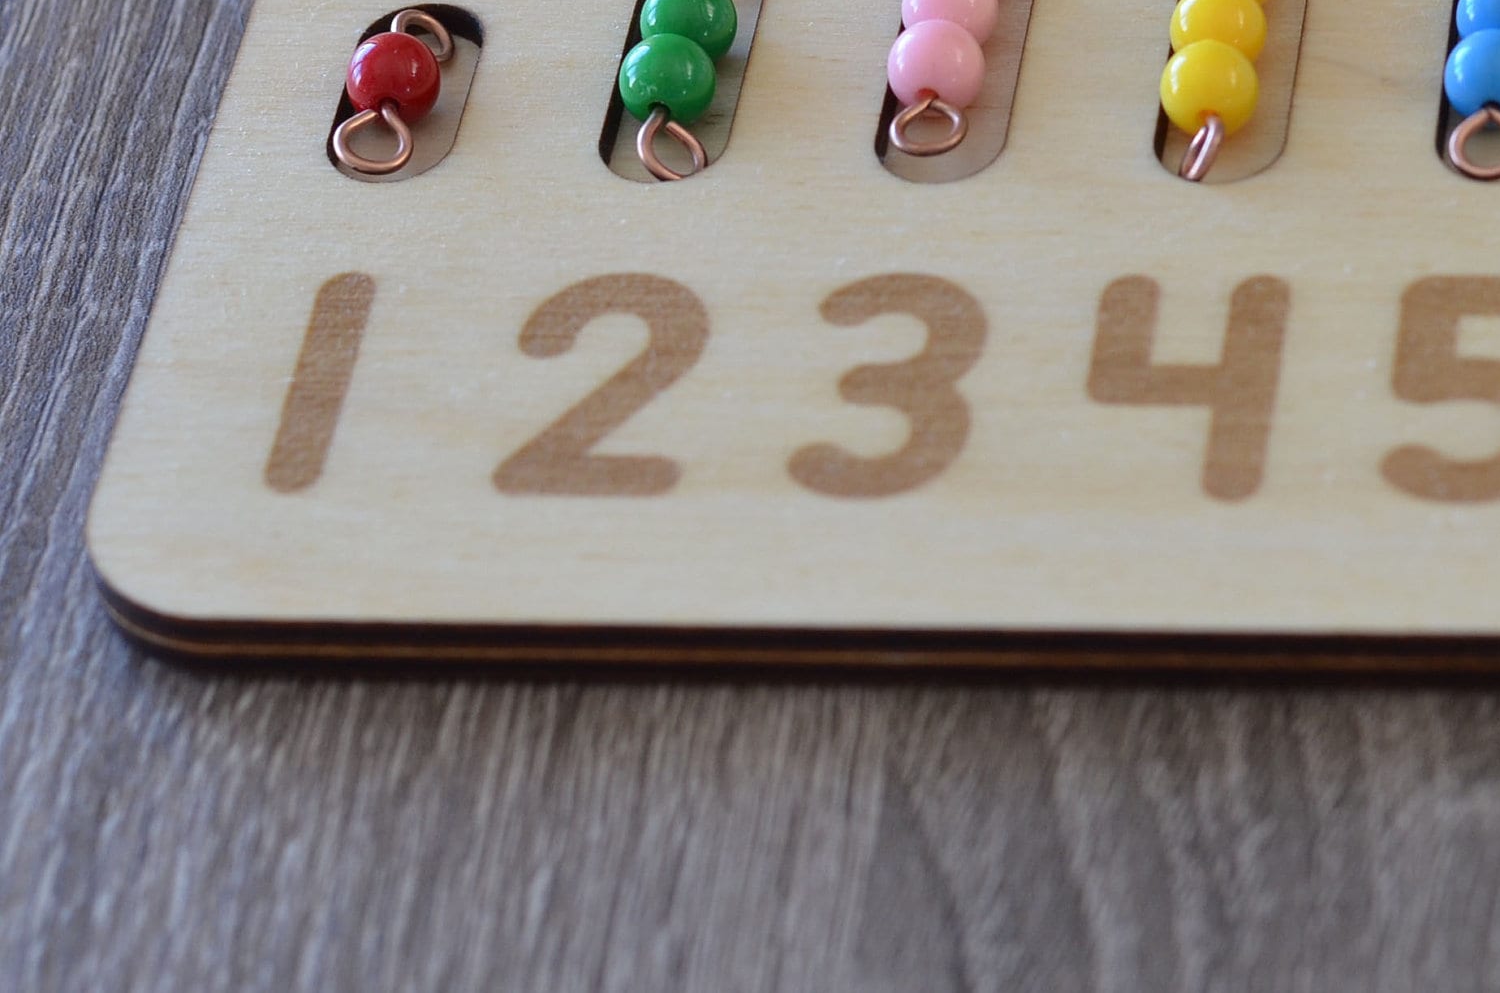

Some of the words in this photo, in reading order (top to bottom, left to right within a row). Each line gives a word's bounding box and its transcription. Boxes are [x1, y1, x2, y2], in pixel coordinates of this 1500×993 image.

[265, 273, 375, 492] 1
[493, 274, 709, 495] 2
[786, 273, 988, 499] 3
[1085, 275, 1292, 502] 4
